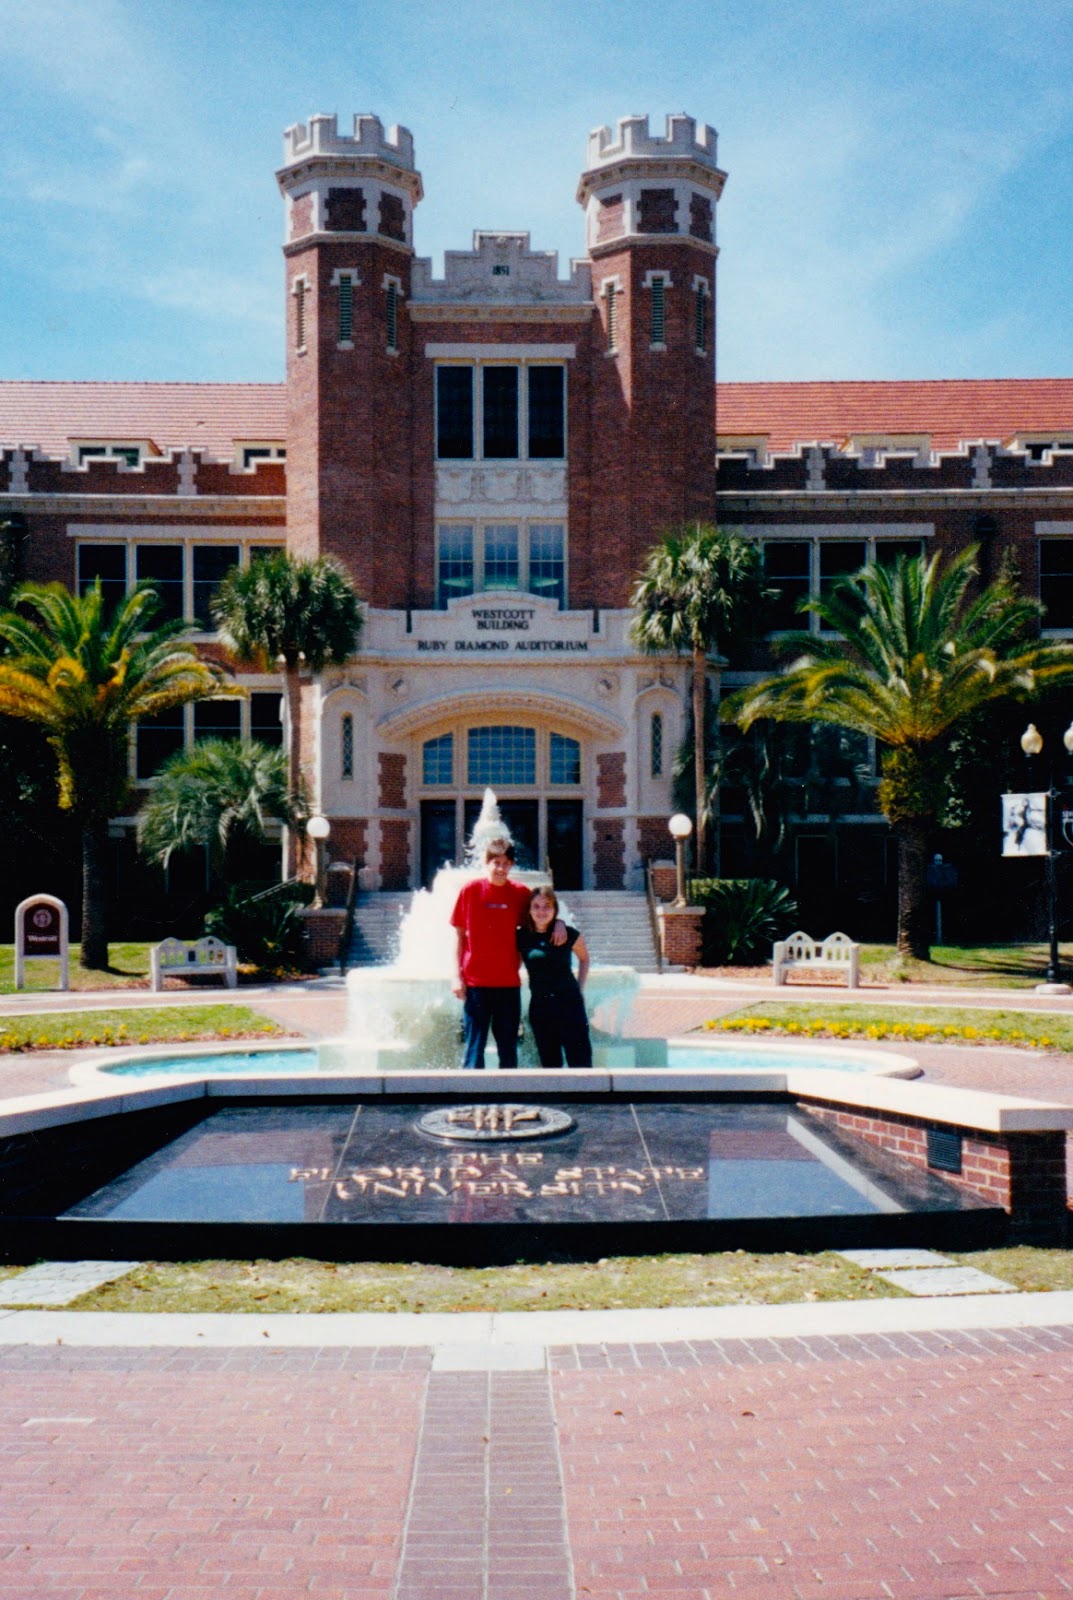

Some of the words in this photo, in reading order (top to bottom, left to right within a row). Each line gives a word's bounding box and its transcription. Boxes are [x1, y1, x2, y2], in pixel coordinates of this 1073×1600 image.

[471, 609, 536, 619] WESTCOTT
[476, 620, 529, 631] BUILDING
[417, 640, 448, 651] RUBY
[454, 640, 509, 651] DIAMOND
[514, 640, 588, 651] AUDITORIUM
[27, 934, 58, 942] Westcott
[448, 1152, 544, 1166] THE
[287, 1165, 519, 1184] FLORIDA
[554, 1165, 709, 1182] STATE
[334, 1181, 656, 1200] UNIVERSITY
